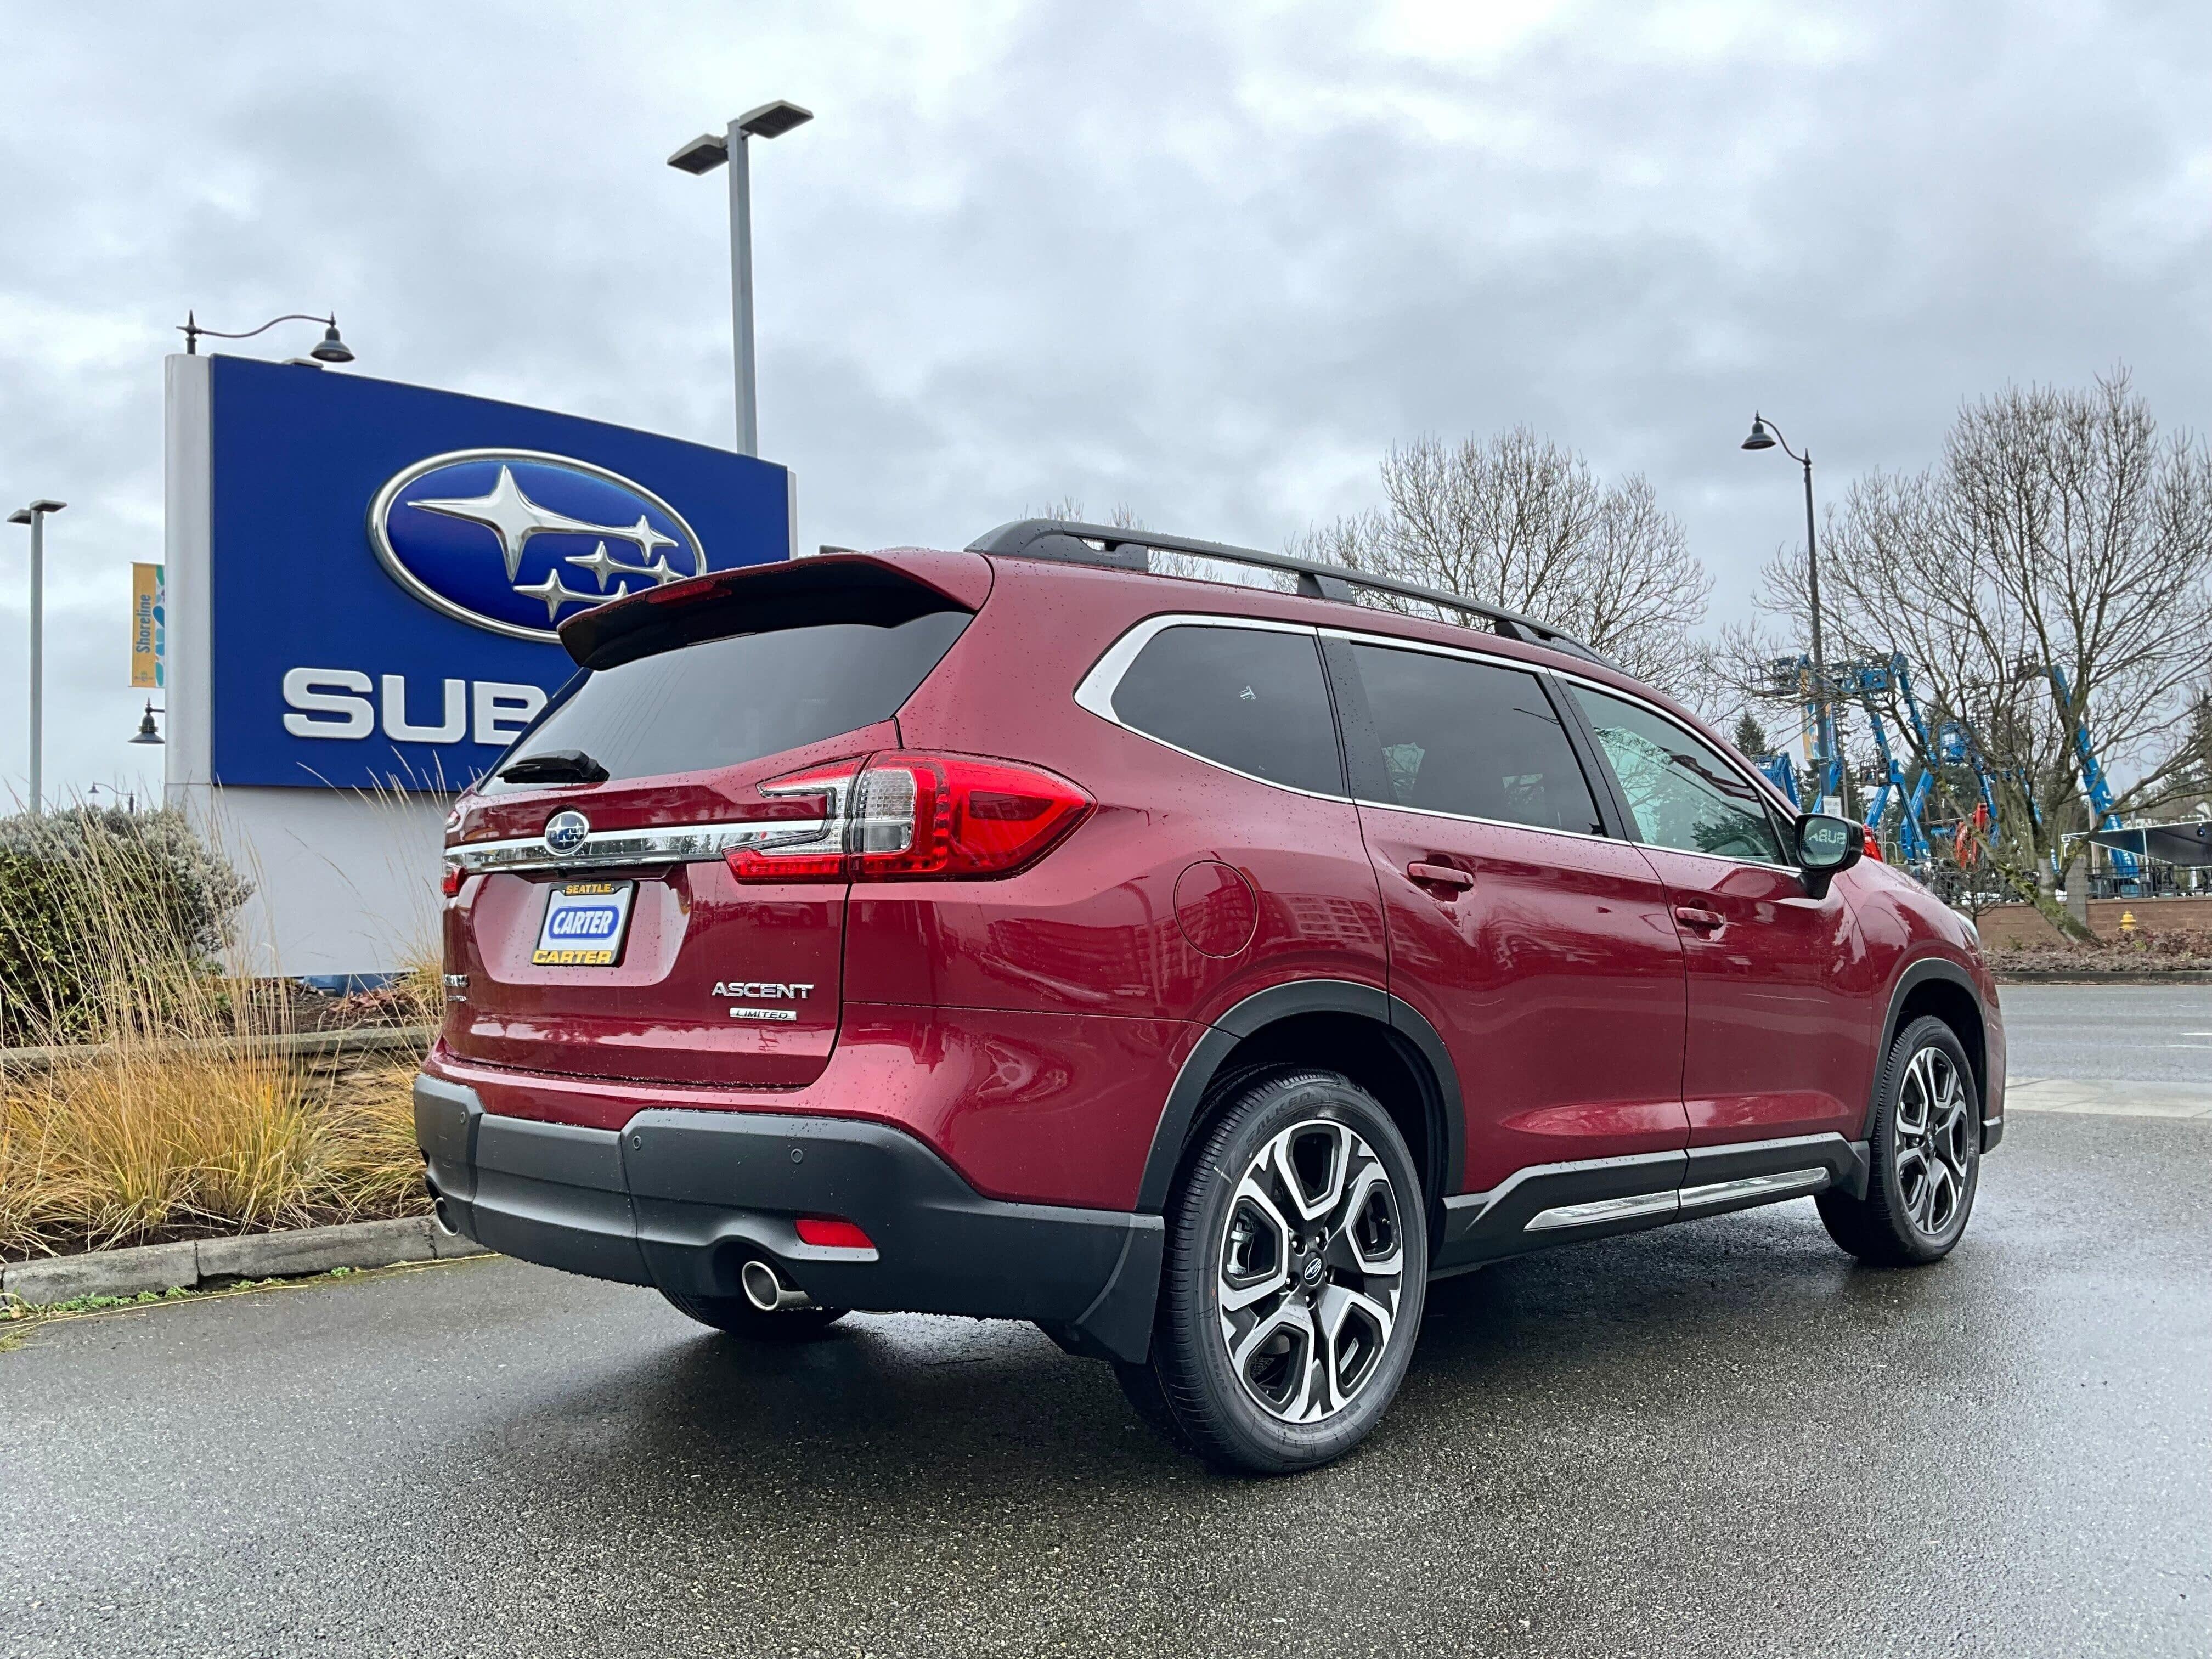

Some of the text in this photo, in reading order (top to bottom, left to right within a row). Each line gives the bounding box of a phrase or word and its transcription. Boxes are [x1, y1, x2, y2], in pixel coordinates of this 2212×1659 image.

[136, 594, 151, 653] Shoreline
[566, 884, 612, 894] SEATTLE
[552, 911, 613, 934] CARTER
[533, 950, 612, 964] CARTER
[712, 982, 814, 999] ASCENT
[737, 1010, 788, 1019] LIMITED
